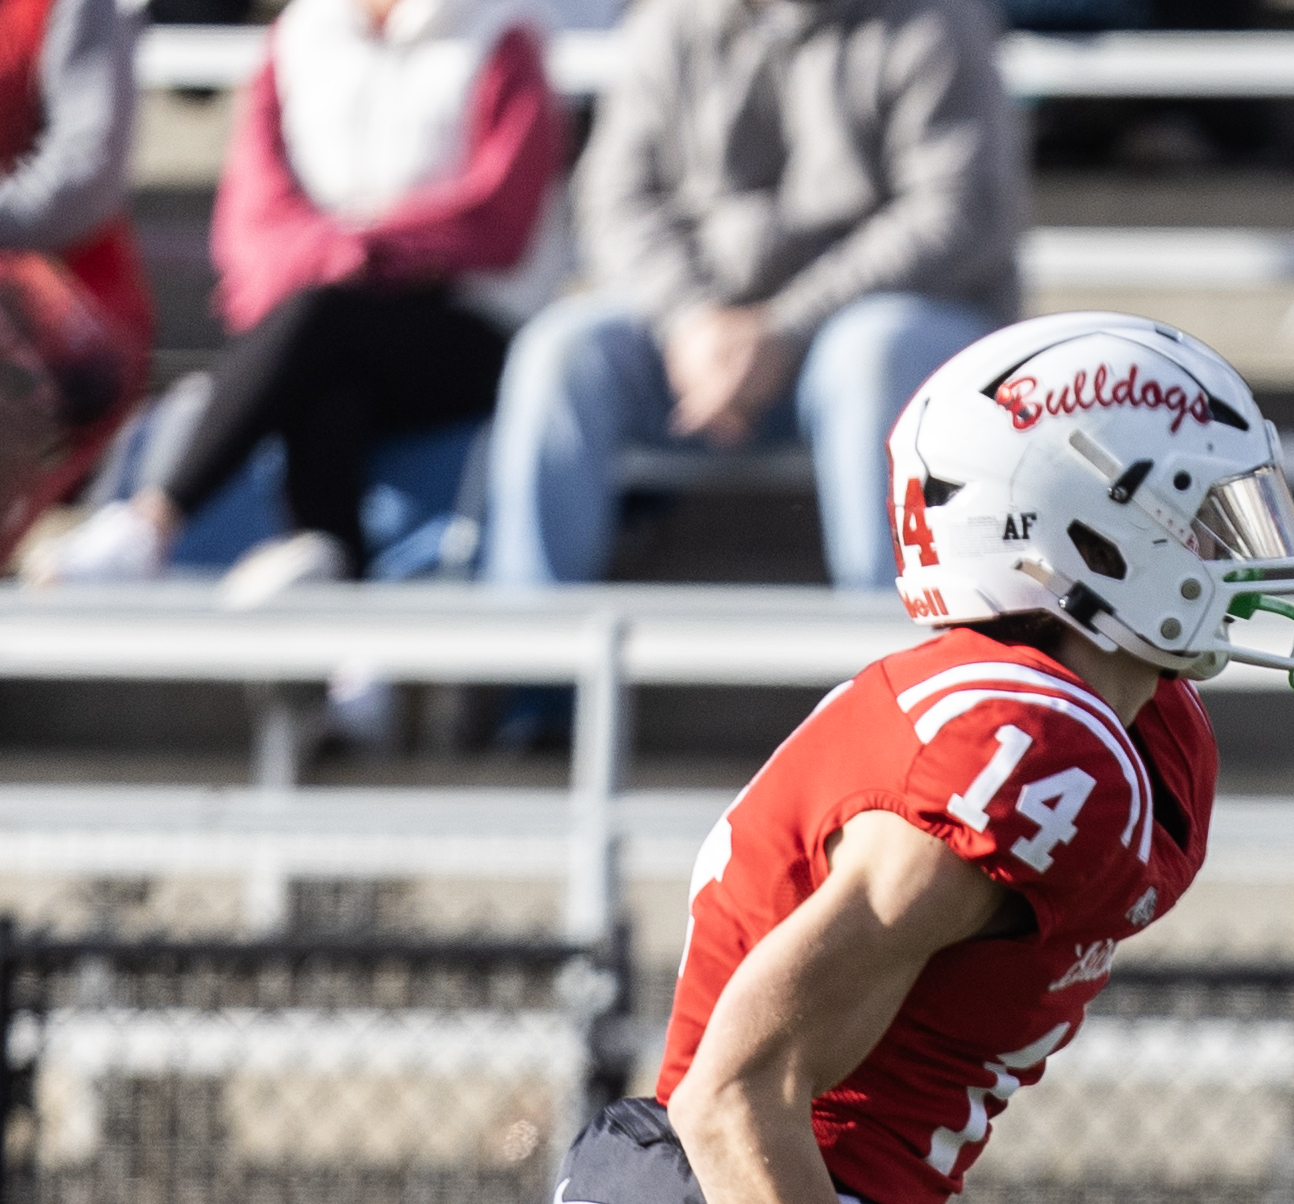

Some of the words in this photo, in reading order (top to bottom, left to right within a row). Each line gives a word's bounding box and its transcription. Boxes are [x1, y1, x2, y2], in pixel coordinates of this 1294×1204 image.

[996, 363, 1212, 434] Bulldogs
[1003, 512, 1036, 540] AF
[948, 723, 1097, 873] 14
